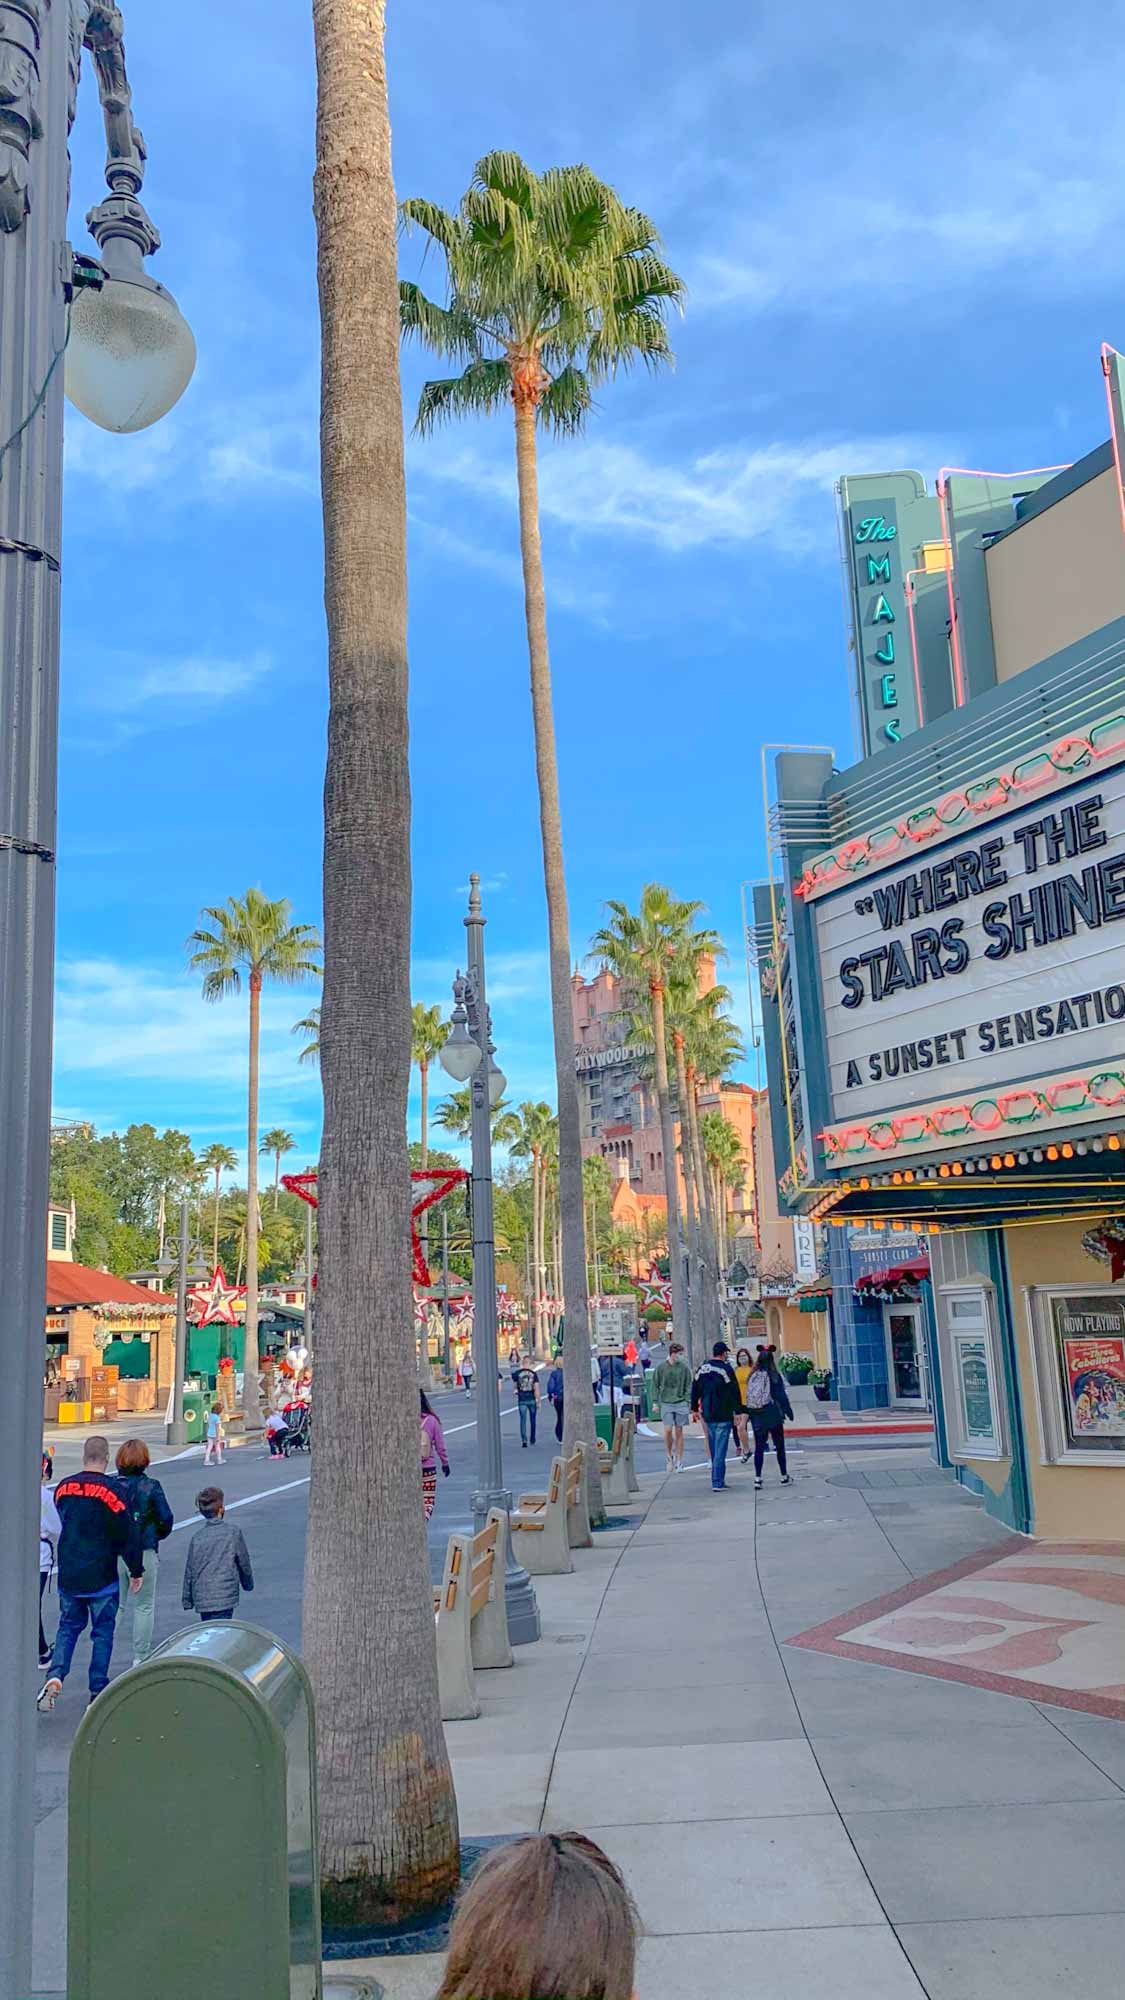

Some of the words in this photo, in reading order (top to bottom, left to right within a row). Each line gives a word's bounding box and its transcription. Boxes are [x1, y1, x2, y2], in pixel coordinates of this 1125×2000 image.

[855, 515, 898, 543] The
[1013, 794, 1108, 875] THE
[839, 918, 970, 1009] STARS
[981, 851, 1125, 960] SHINE
[845, 1060, 863, 1088] A
[868, 1029, 967, 1082] SUNSET
[978, 984, 1125, 1053] SENSATIO
[1063, 1317, 1084, 1332] NOW
[1085, 1315, 1121, 1332] PLAYING
[84, 1483, 126, 1513] WARS
